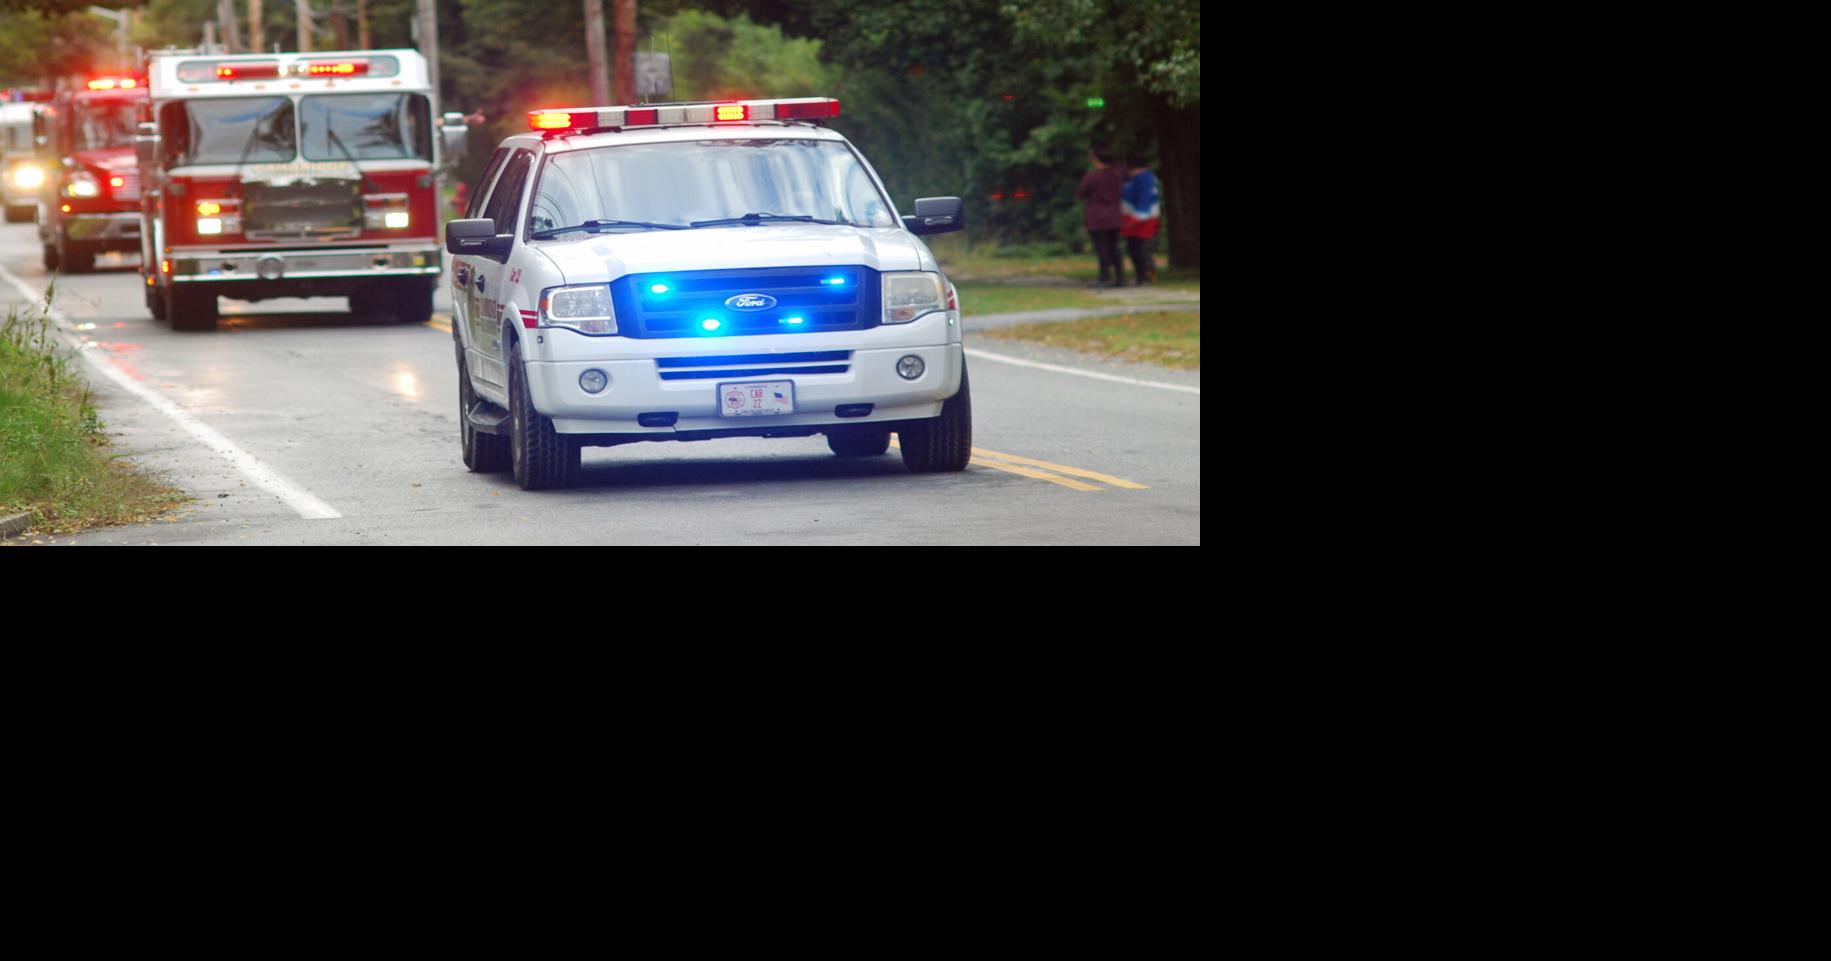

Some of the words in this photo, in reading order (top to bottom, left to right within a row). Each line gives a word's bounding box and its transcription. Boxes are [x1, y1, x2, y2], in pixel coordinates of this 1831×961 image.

[736, 296, 765, 307] Ford
[750, 389, 764, 399] CAR
[753, 399, 763, 408] 22
